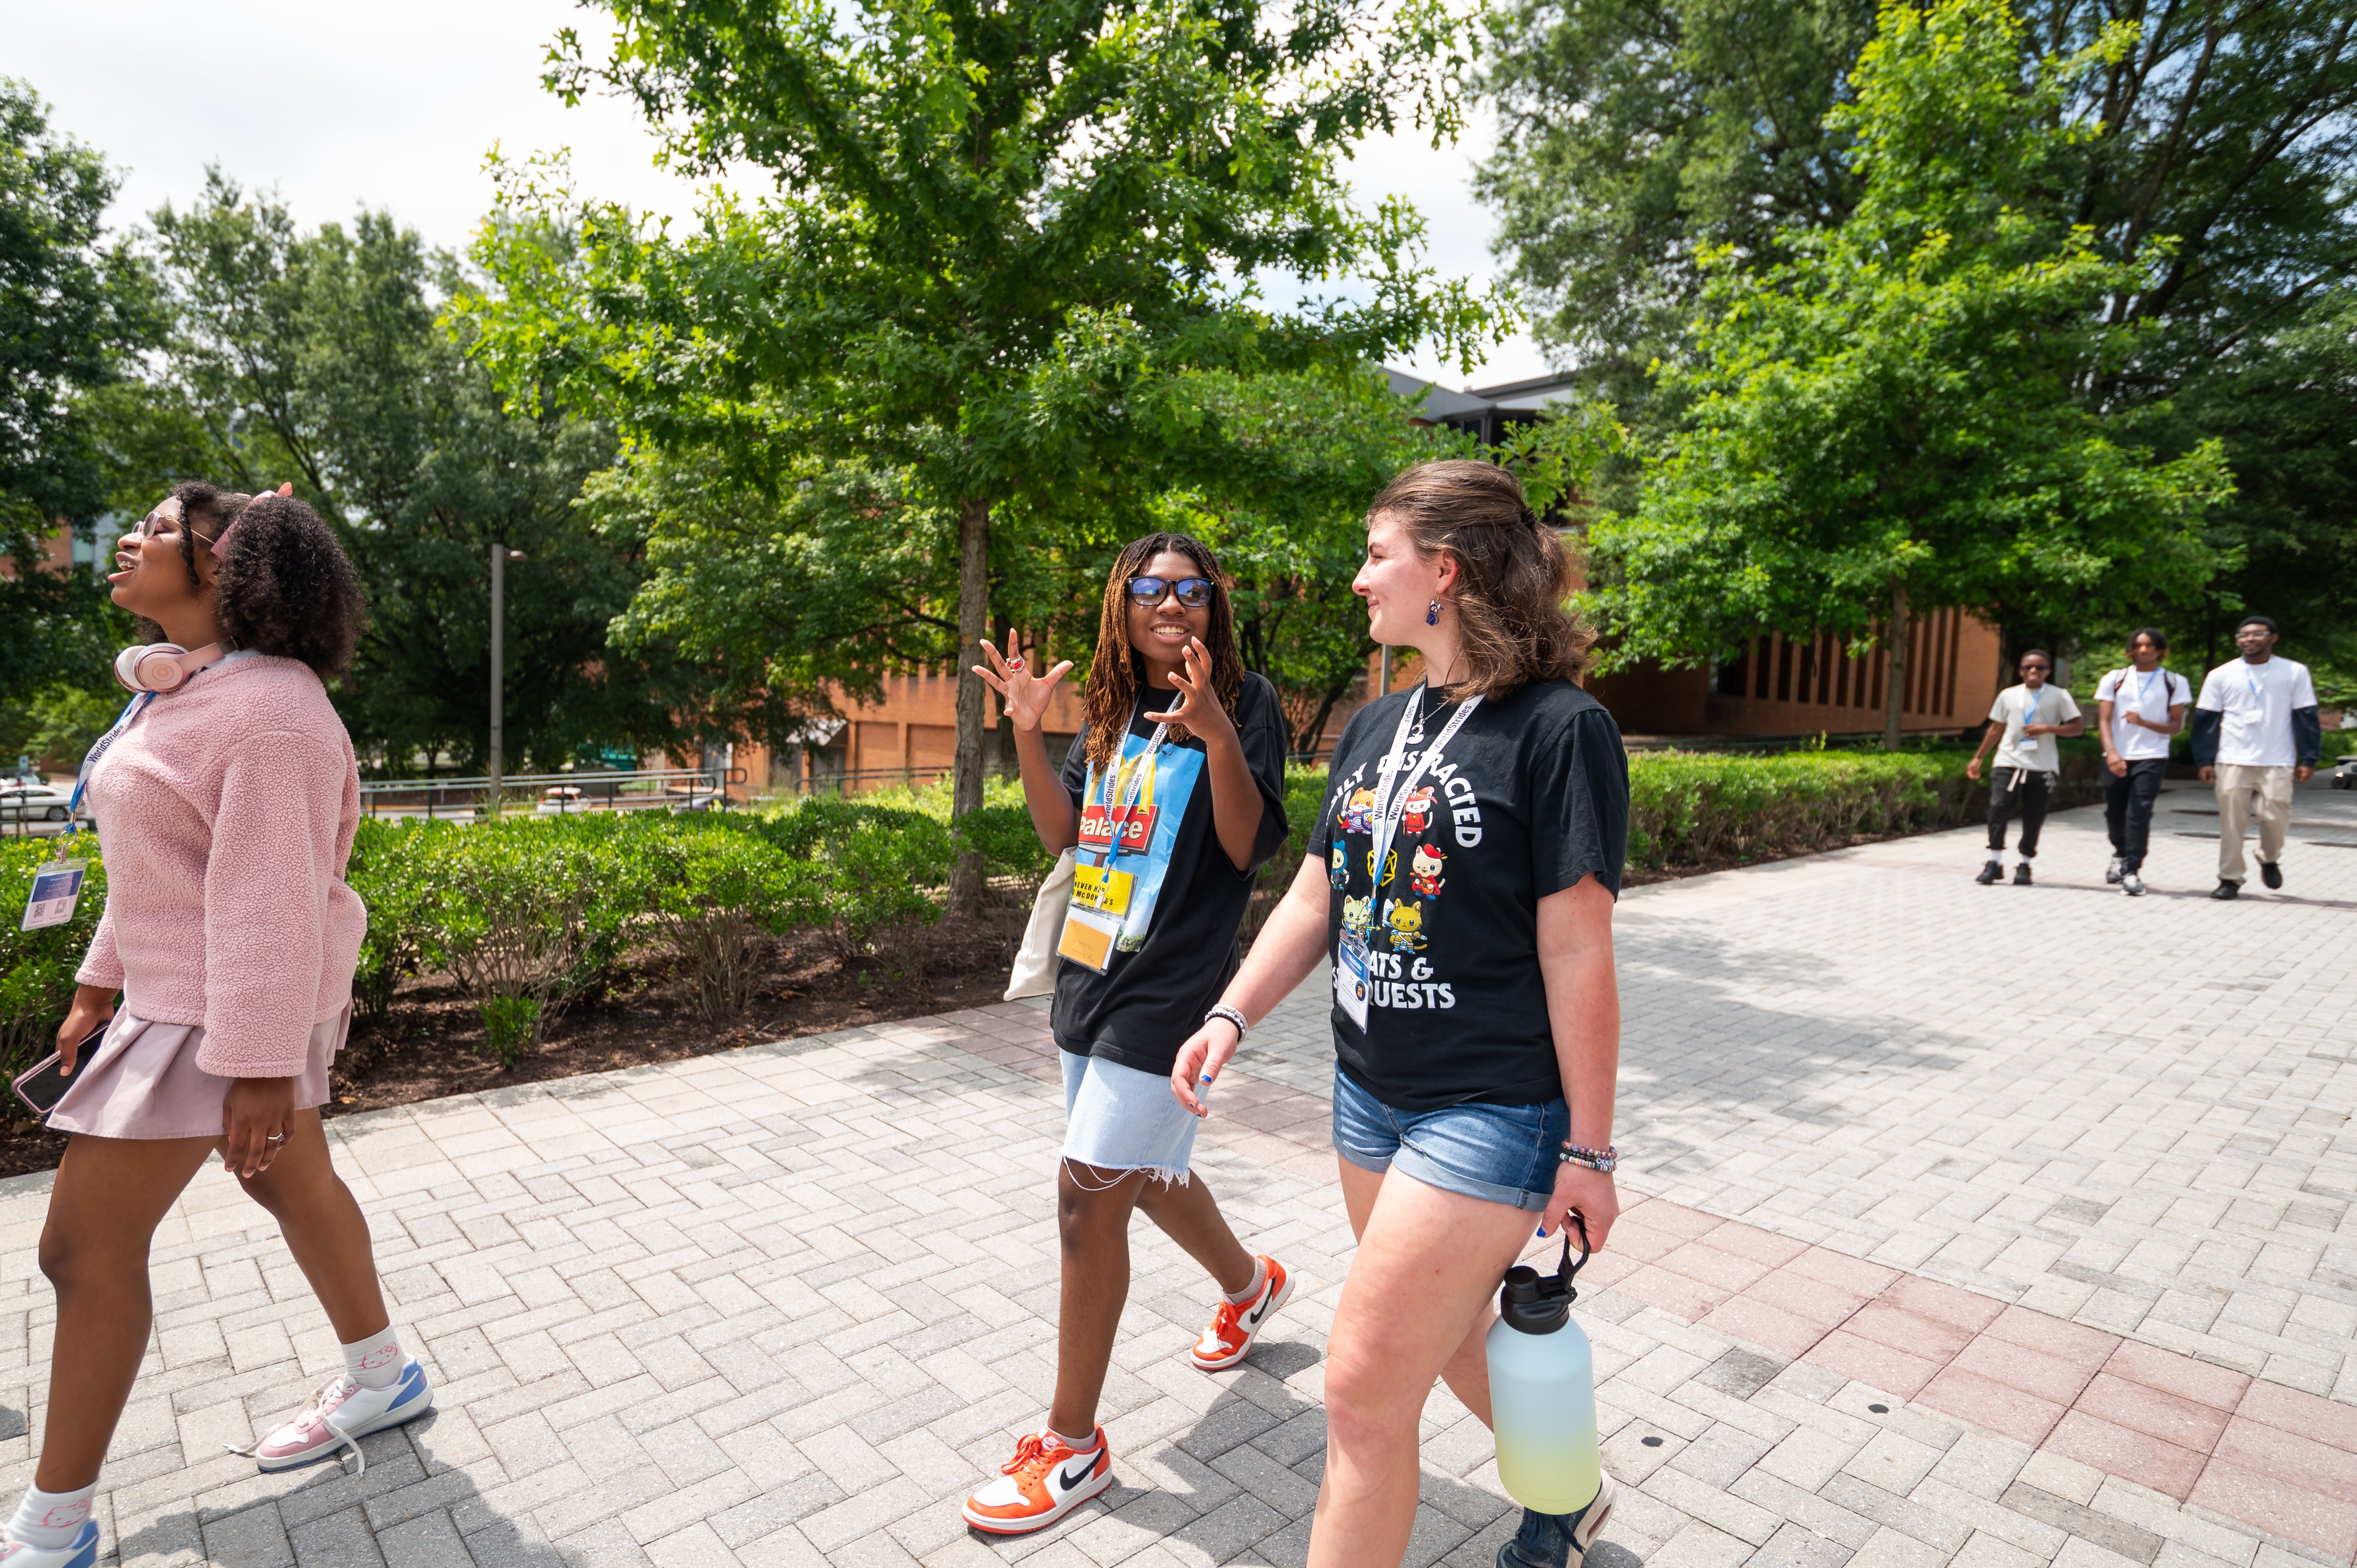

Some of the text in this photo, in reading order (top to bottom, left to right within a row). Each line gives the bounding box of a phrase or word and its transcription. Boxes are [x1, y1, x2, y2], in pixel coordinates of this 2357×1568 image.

[86, 724, 124, 763] WorldStrides
[1146, 722, 1166, 755] WorldStrid
[1433, 704, 1472, 749] WorldStrides
[1105, 775, 1116, 816] WorldStrides
[1125, 773, 1142, 814] WorldStrides
[1326, 761, 1368, 826] SILY
[1080, 816, 1143, 839] Palace
[1075, 881, 1092, 891] NEVER
[1076, 890, 1114, 906] McDOND'S
[1360, 950, 1402, 979] ATS
[1411, 957, 1434, 980] &
